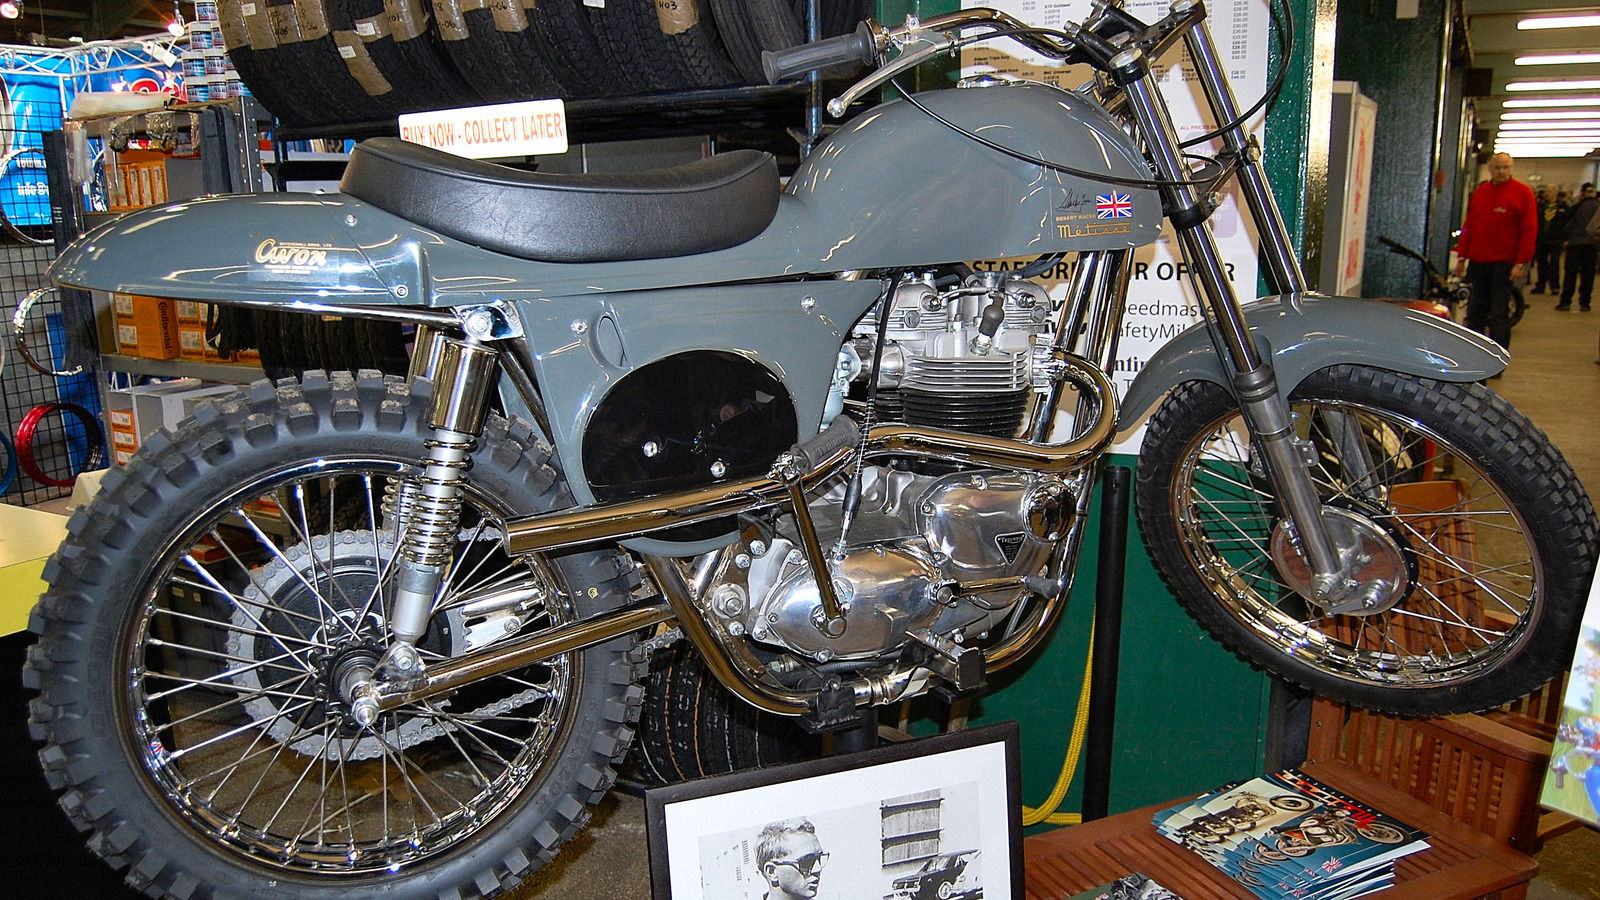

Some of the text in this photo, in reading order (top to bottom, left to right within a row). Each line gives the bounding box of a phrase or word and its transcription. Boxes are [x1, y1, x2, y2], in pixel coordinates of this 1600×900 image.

[428, 122, 455, 148] NOW
[464, 117, 518, 145] COLLECT
[521, 112, 566, 141] LATER
[1057, 222, 1131, 238] Métisse
[973, 258, 1079, 280] STAFOR
[158, 301, 173, 350] Continental
